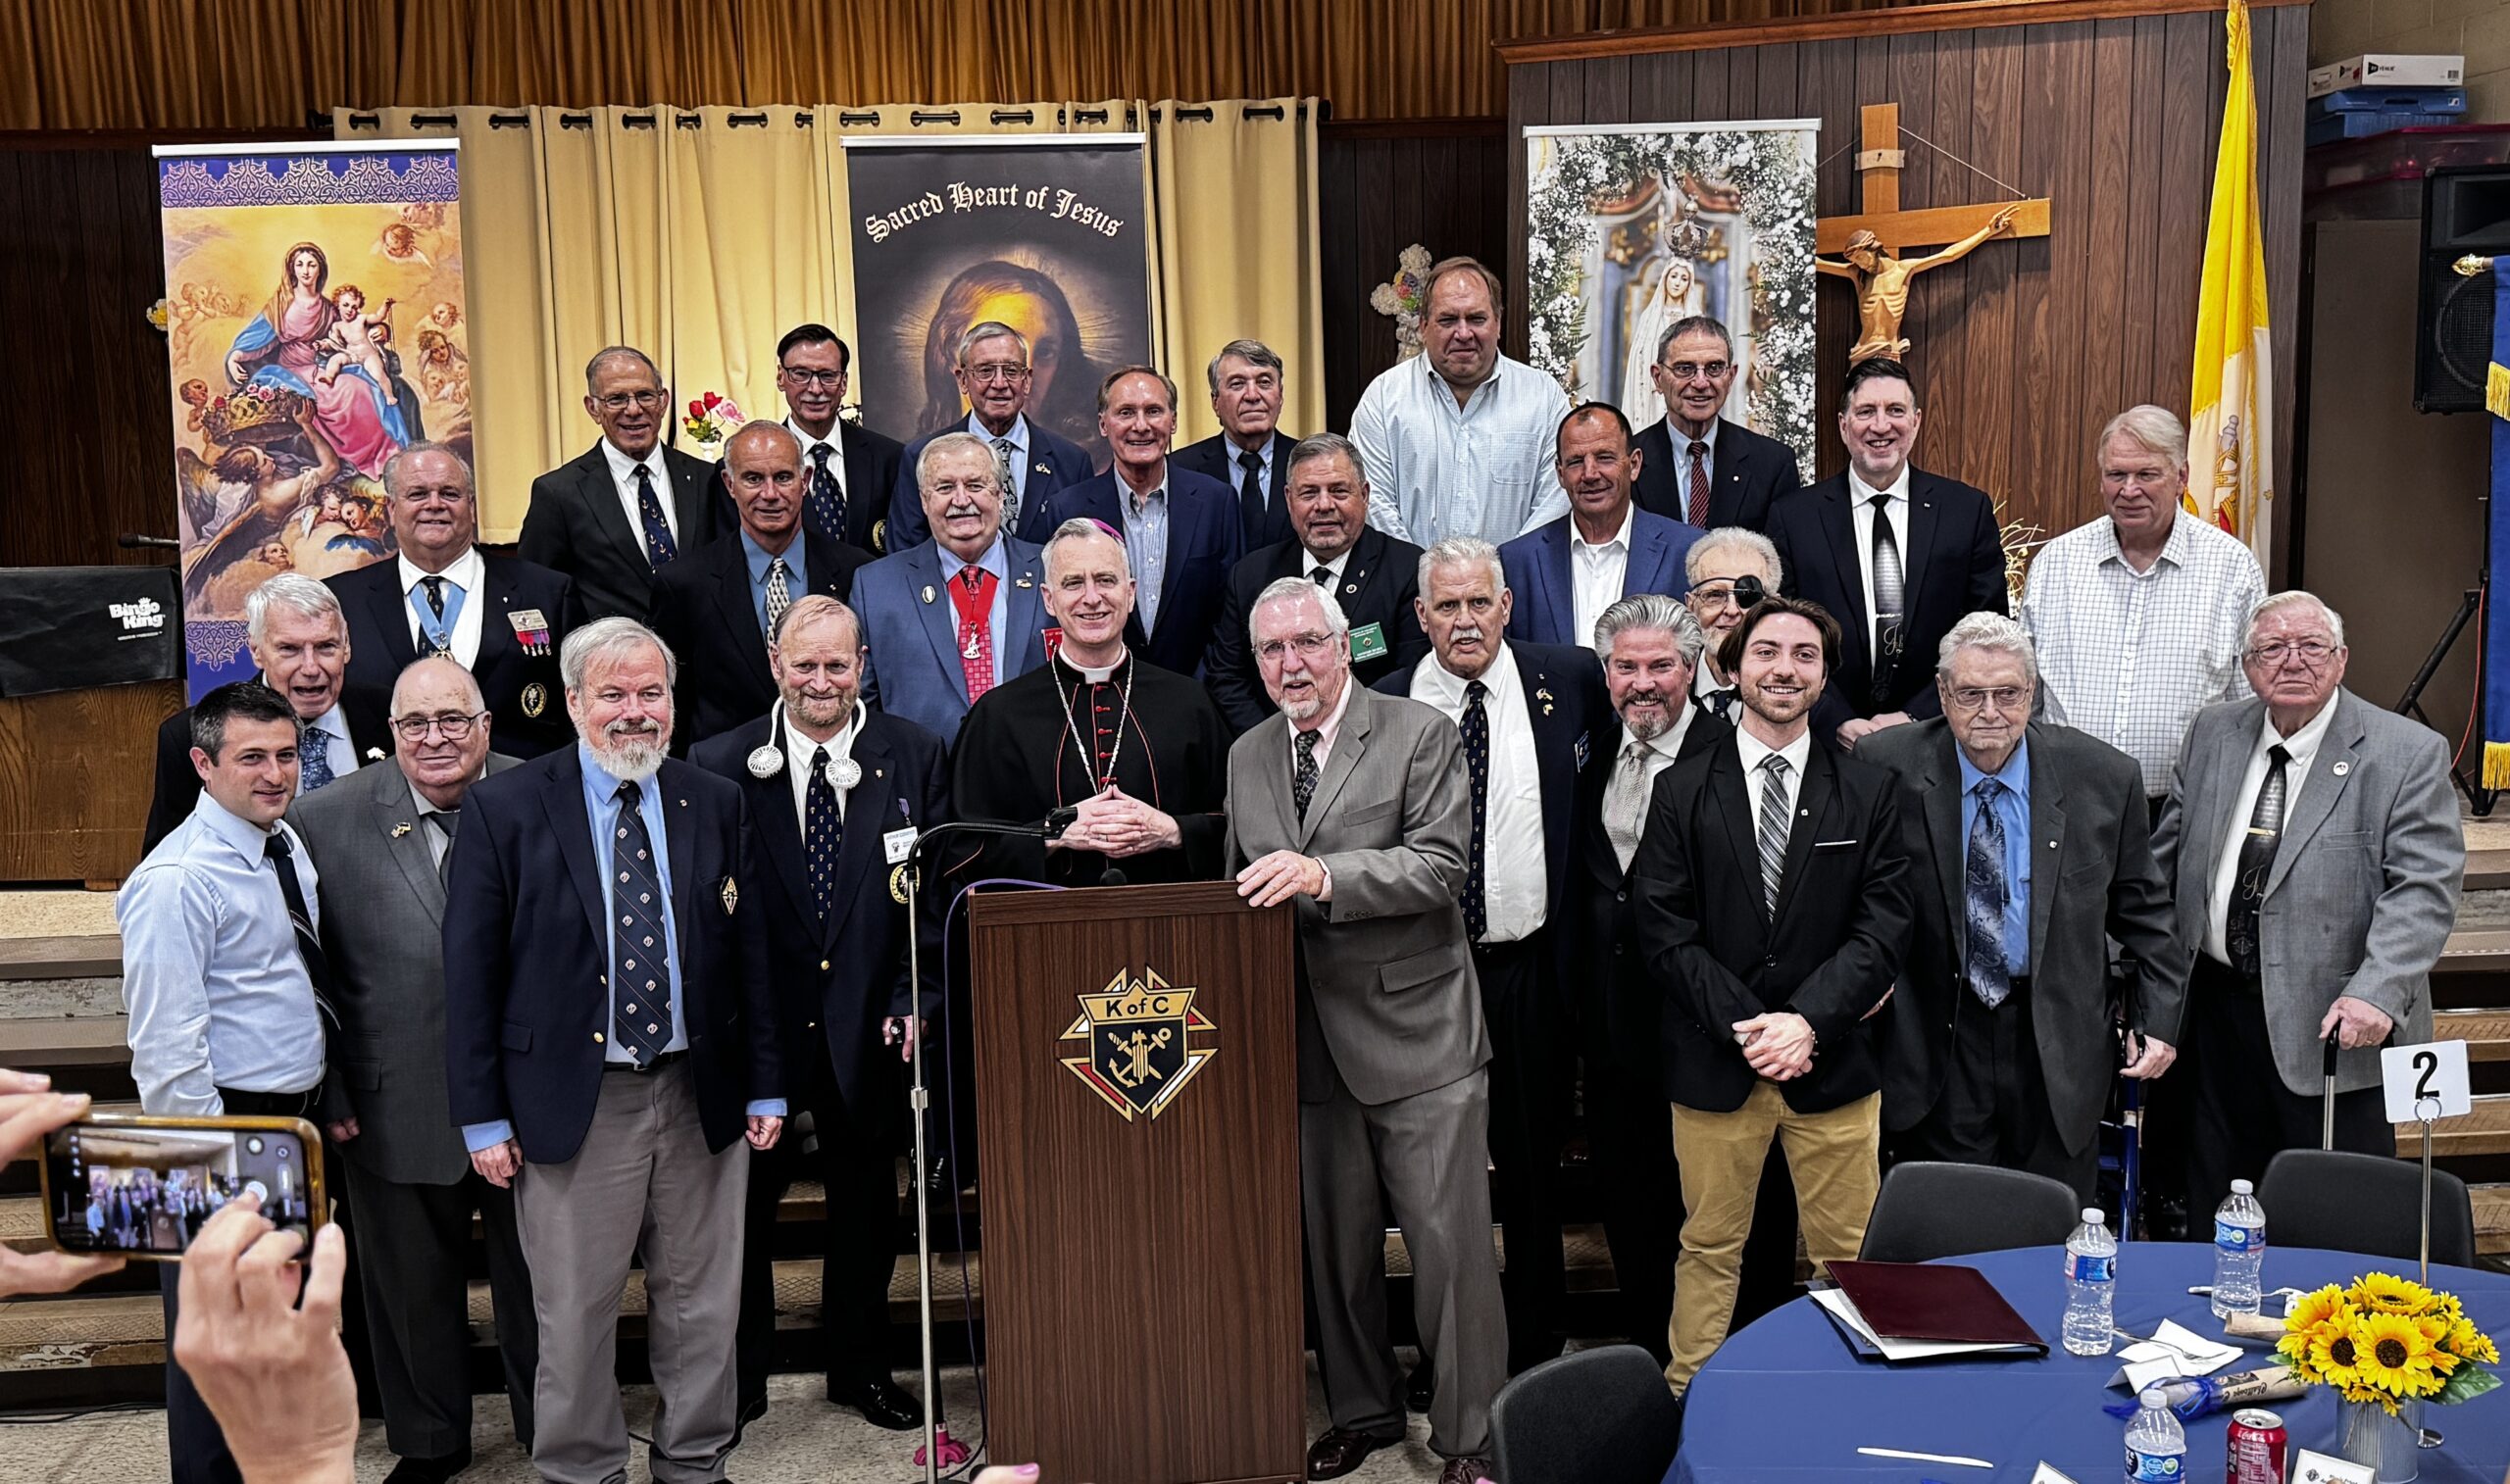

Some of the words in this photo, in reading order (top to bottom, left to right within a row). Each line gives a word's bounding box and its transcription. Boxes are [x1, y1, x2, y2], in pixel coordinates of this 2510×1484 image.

[865, 192, 944, 243] Sacred
[947, 181, 1019, 214] Heart
[1025, 185, 1049, 211] of
[1050, 188, 1124, 237] Jesus
[109, 601, 161, 618] Bingo
[123, 614, 164, 629] King
[1106, 999, 1123, 1017] K
[1129, 998, 1148, 1014] of
[1152, 996, 1170, 1014] C
[2413, 1051, 2440, 1100] 2
